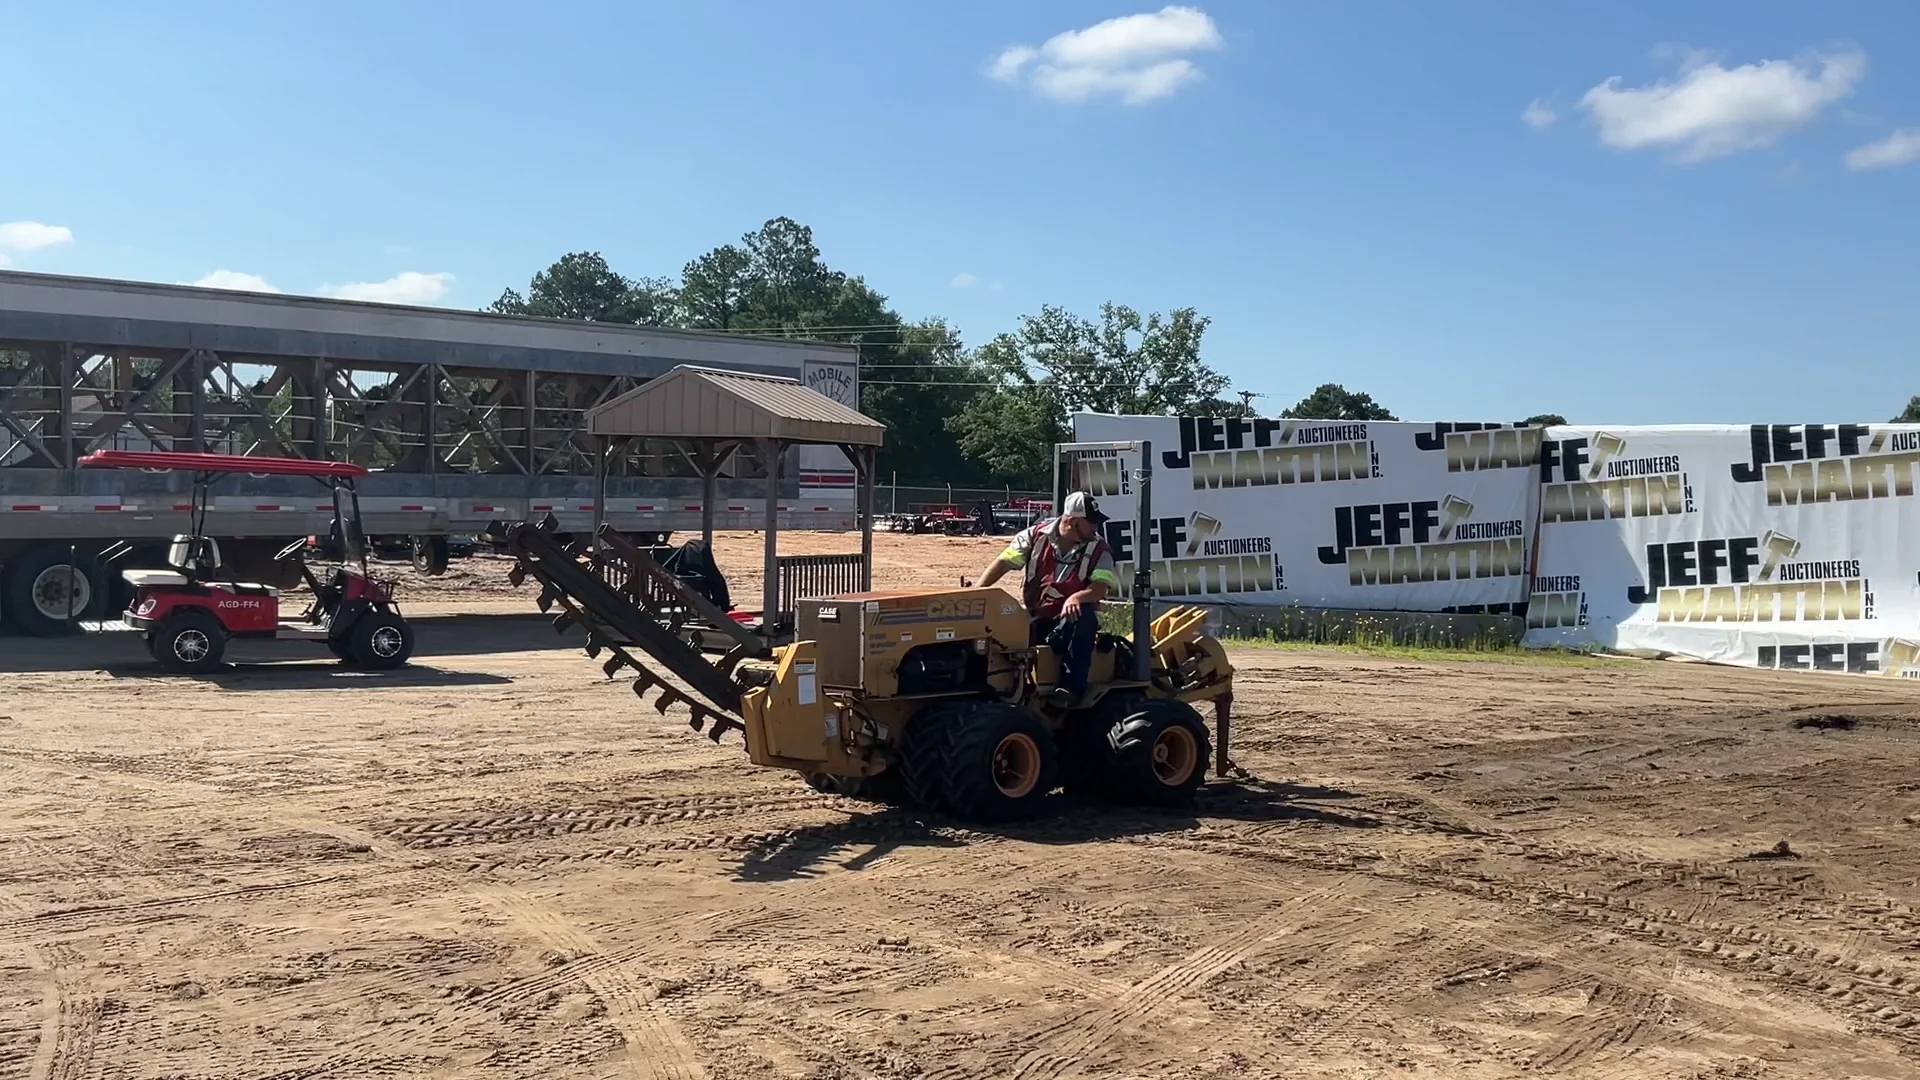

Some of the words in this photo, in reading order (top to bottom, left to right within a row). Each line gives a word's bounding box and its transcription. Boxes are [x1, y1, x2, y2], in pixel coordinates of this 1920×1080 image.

[808, 368, 852, 388] MOBILE
[1163, 417, 1280, 469] JEFF
[1298, 424, 1367, 445] AUCTIONEERS
[1191, 441, 1369, 490] MARTIN
[1731, 424, 1869, 483] JEFF
[1607, 455, 1680, 479] AUCTIONEERS
[1317, 501, 1439, 565] JEFF
[1455, 519, 1523, 541] AUCTIONEERS
[1204, 537, 1271, 556] AUCTIONEERS
[1348, 536, 1522, 586] MARTIN
[1627, 537, 1760, 604] JEFF
[1780, 559, 1860, 581] AUCTIONEERS
[819, 607, 837, 615] CASE
[926, 598, 986, 618] CASE
[1656, 579, 1861, 622] MARTIN
